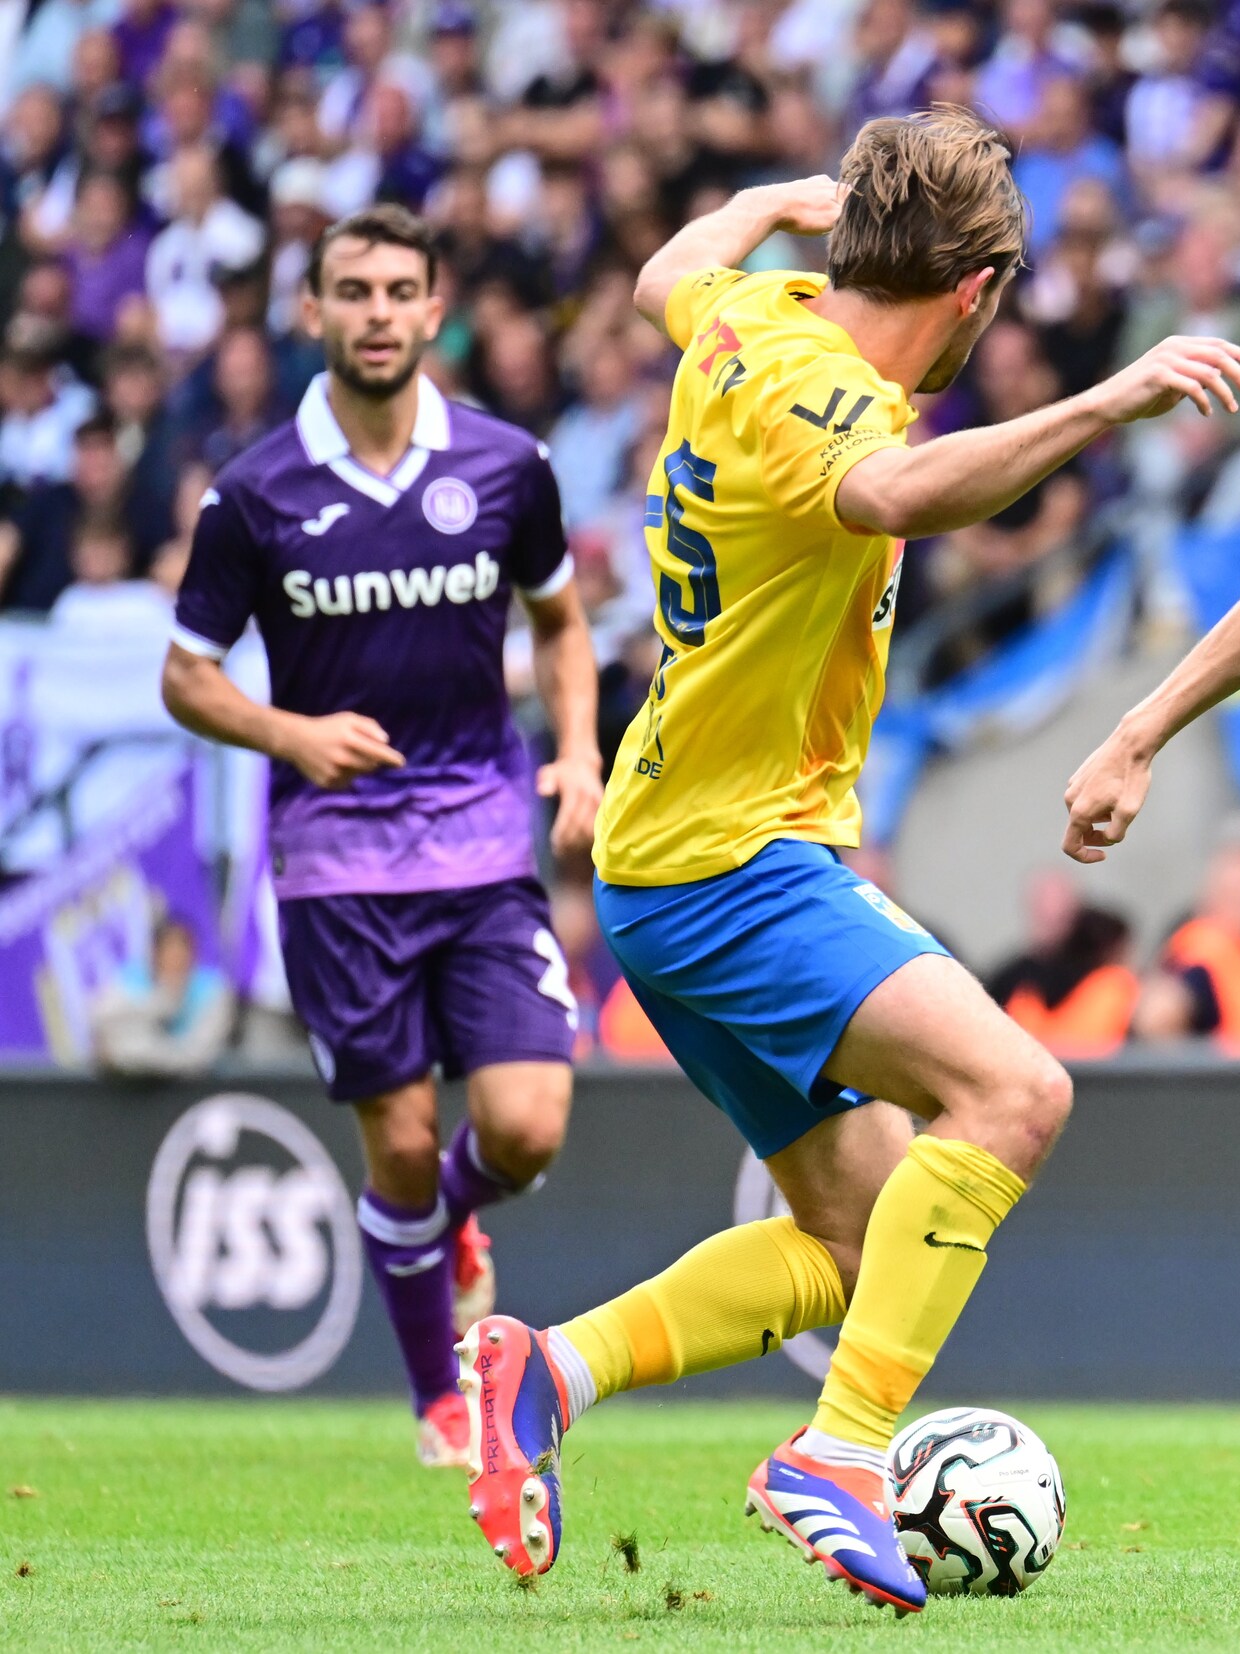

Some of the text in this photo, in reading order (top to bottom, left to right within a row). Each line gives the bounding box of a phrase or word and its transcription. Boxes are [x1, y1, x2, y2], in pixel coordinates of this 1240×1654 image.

[819, 449, 843, 477] VAN
[282, 550, 500, 619] Sunweb
[643, 437, 722, 648] 5
[480, 1353, 500, 1476] PREDATOR
